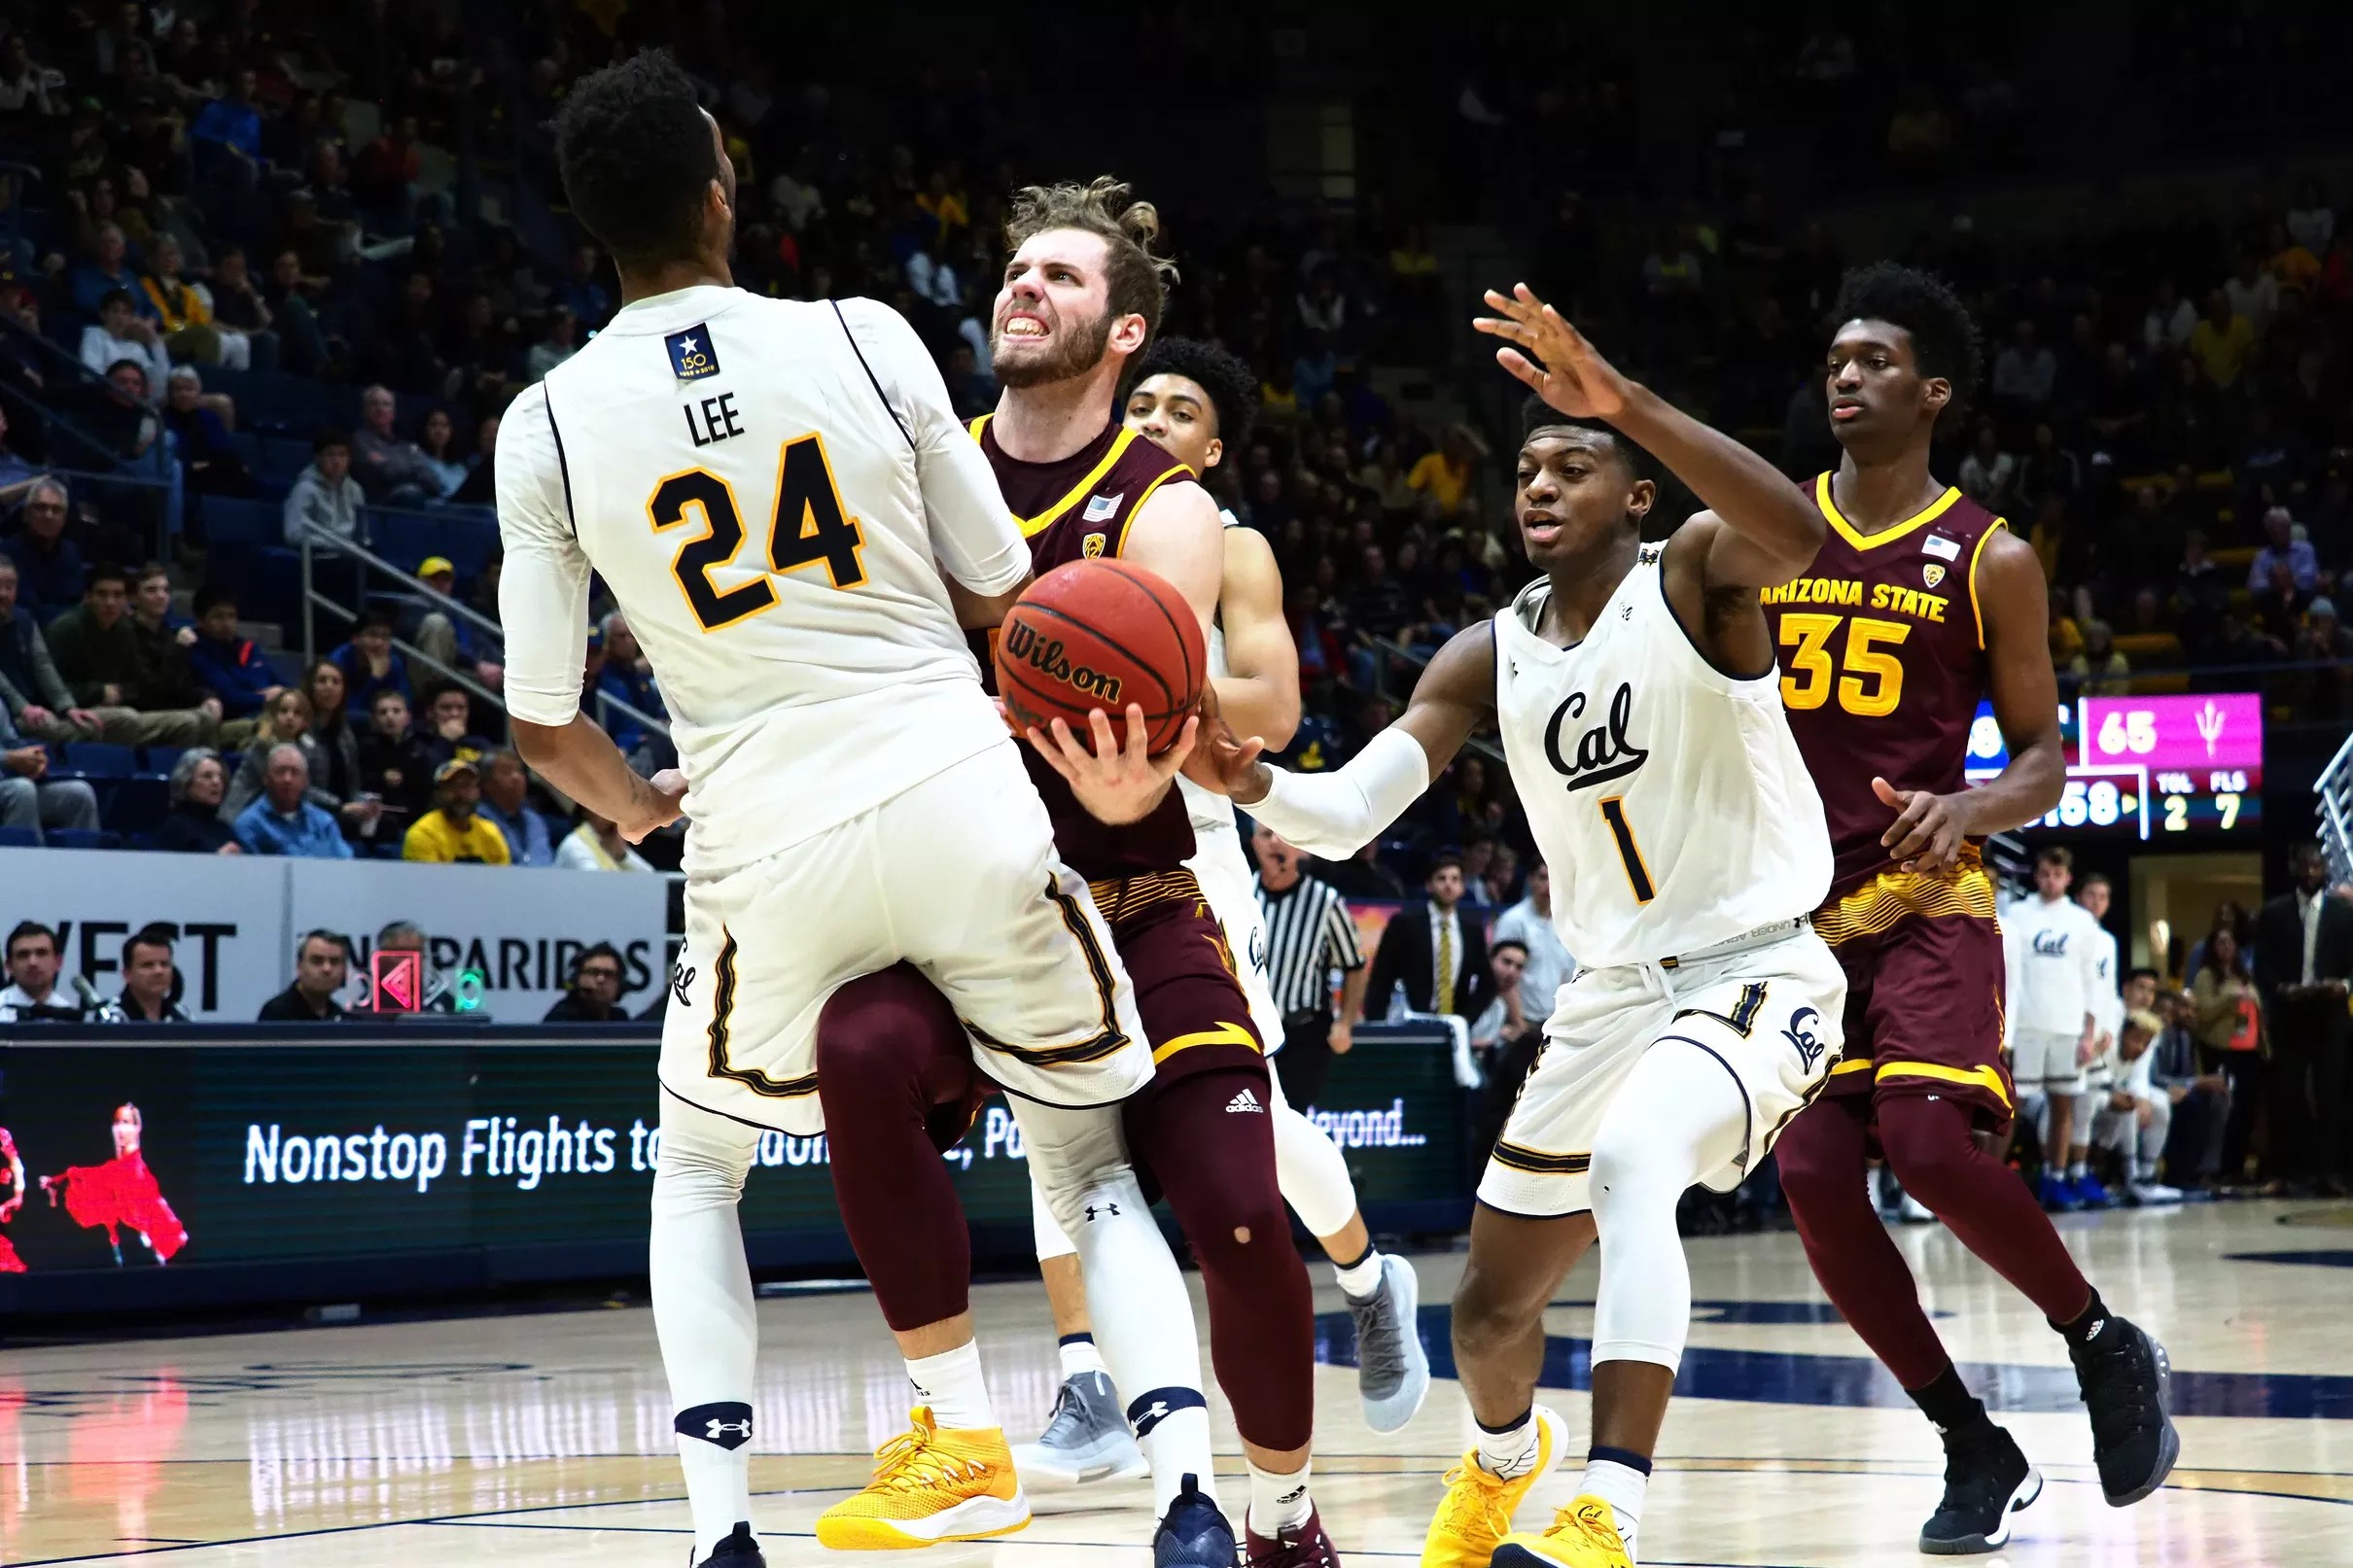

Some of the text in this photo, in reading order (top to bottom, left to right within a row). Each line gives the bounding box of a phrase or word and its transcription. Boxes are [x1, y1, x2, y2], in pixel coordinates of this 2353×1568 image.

[681, 354, 707, 370] 150
[684, 392, 745, 447] LEE
[646, 431, 869, 633] 24
[1759, 578, 1949, 623] ARIZONA STATE
[1006, 619, 1122, 705] Wilson
[1779, 613, 1912, 716] 35
[1544, 681, 1649, 791] Cal
[2097, 711, 2157, 755] 65
[2164, 793, 2241, 831] 2 7
[1598, 795, 1657, 906] 1
[430, 936, 652, 993] PARIBS
[2032, 928, 2068, 958] Cal
[1225, 1102, 1264, 1114] adidas
[244, 1124, 447, 1194] Nonstop
[461, 1115, 616, 1190] Flights
